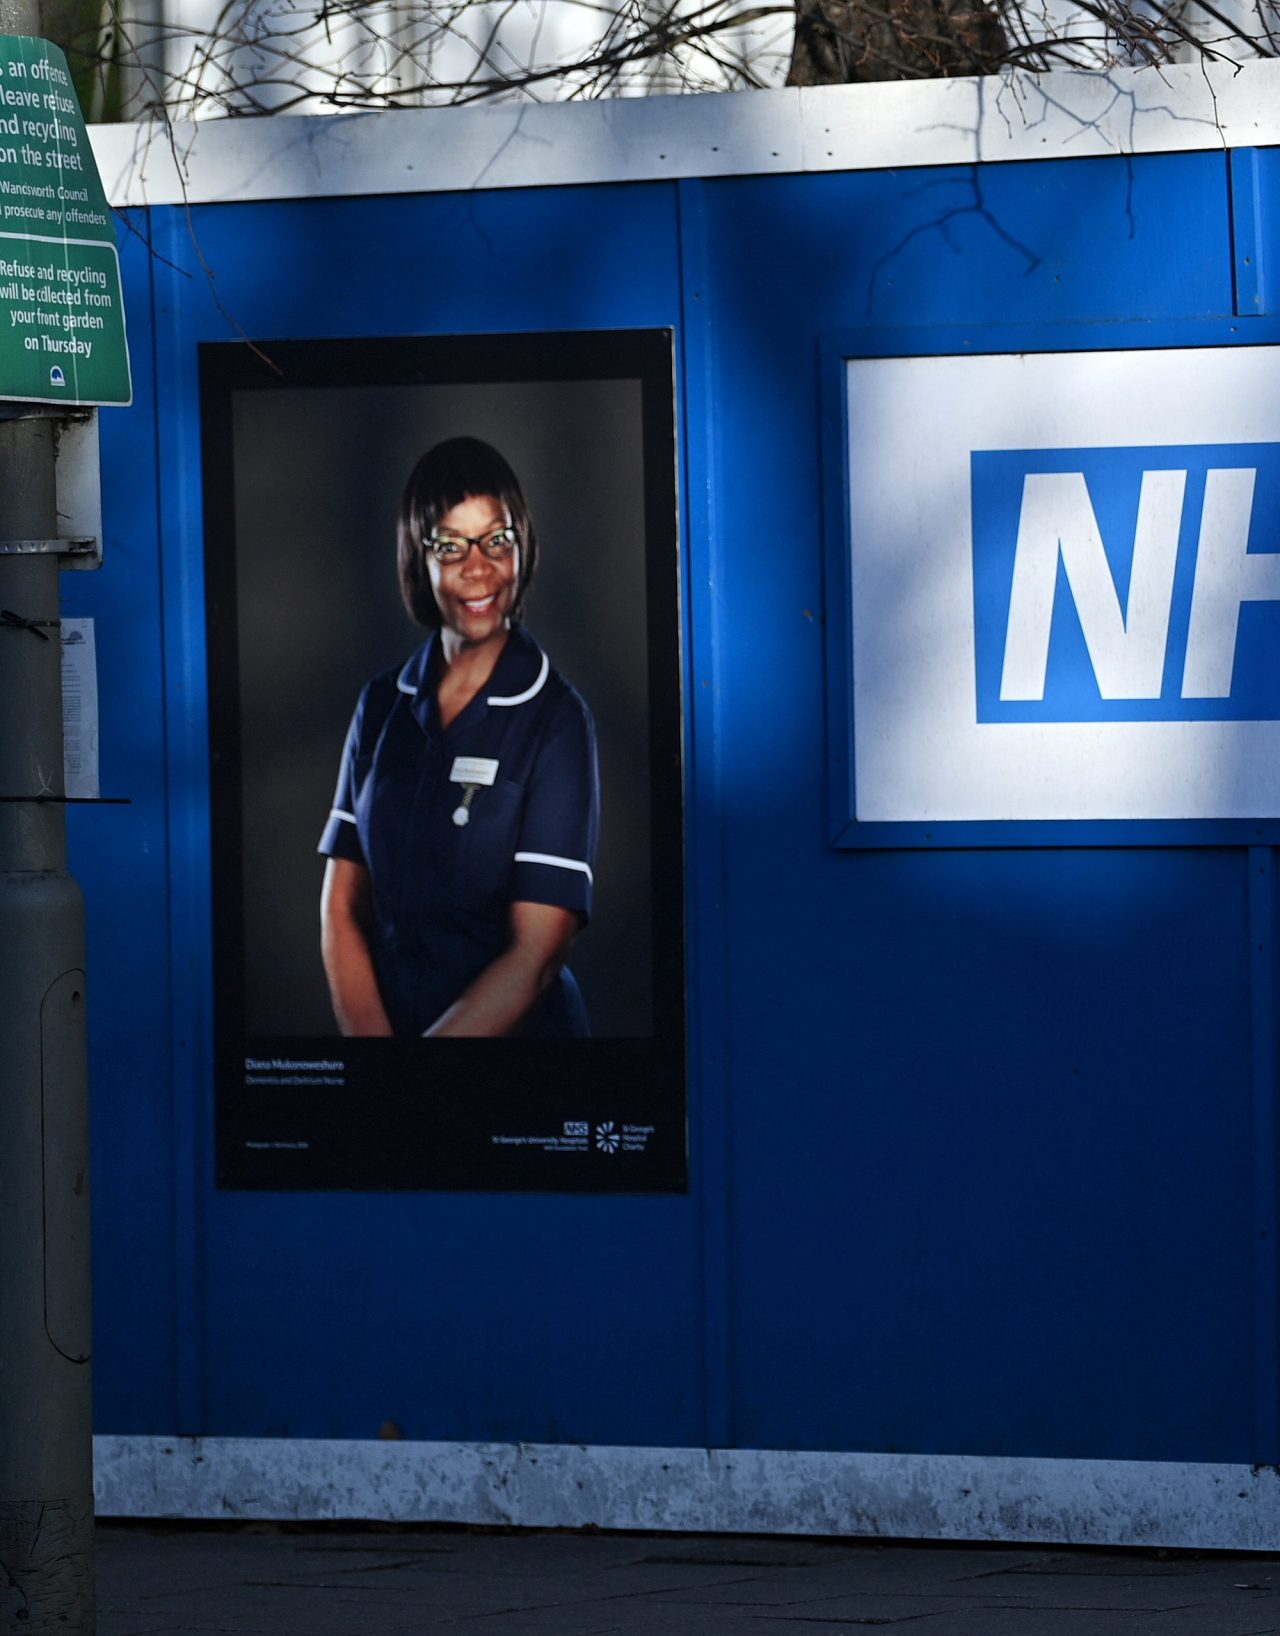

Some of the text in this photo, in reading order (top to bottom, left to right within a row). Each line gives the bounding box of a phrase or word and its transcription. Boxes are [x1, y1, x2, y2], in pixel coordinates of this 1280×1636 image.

[8, 61, 28, 78] an
[30, 59, 69, 86] offence
[0, 84, 75, 114] leave refuse
[22, 118, 78, 147] recycling
[0, 144, 83, 171] on the street
[57, 186, 89, 202] Council
[4, 205, 45, 220] prosecute
[46, 210, 62, 225] any
[65, 208, 107, 225] offenders
[0, 259, 107, 289] Refuse and recycling
[0, 283, 112, 307] will be collected from
[10, 307, 104, 332] your front garden
[24, 334, 92, 359] on Thursday
